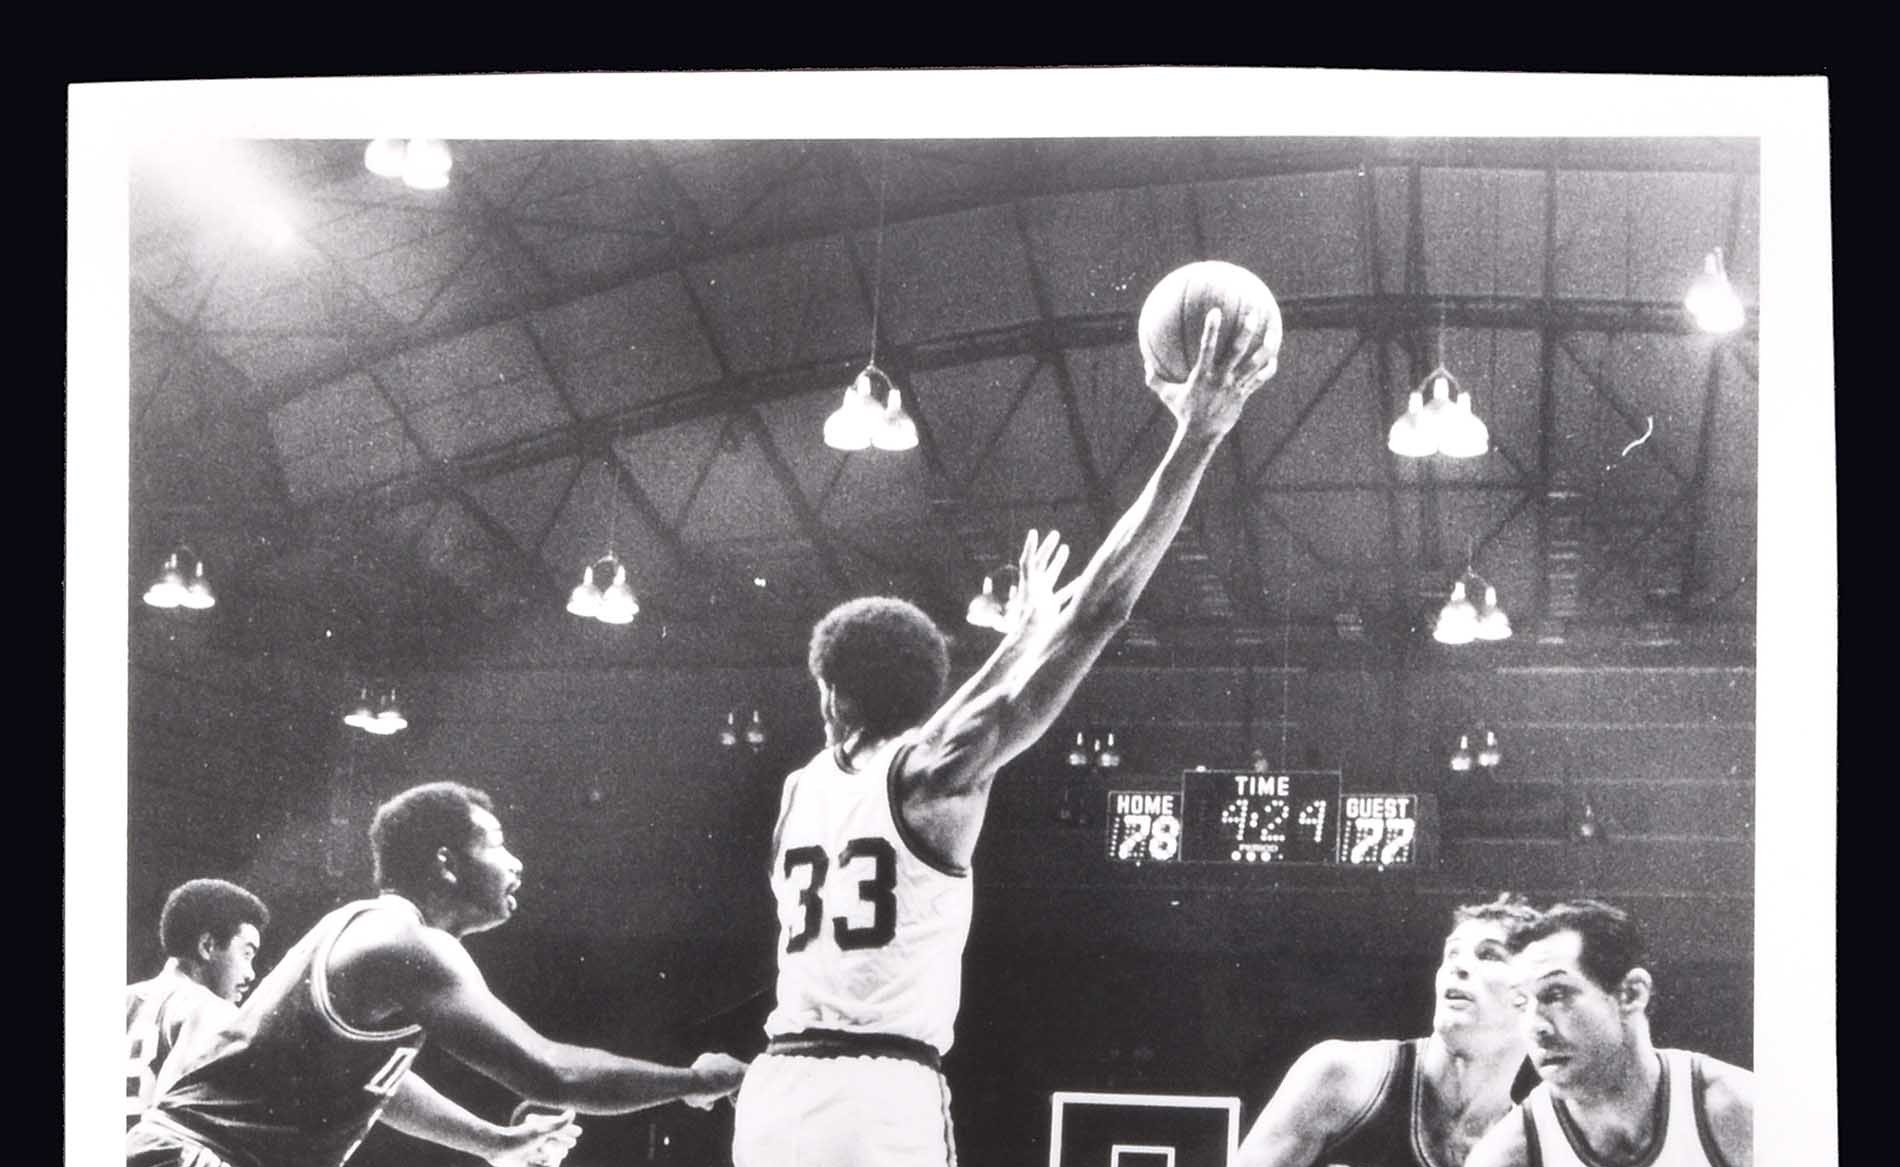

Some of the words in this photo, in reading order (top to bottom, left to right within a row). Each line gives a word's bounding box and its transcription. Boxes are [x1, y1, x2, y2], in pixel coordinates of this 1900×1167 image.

[1234, 776, 1290, 796] TIME
[1117, 794, 1174, 815] HOME
[1346, 798, 1410, 818] GUEST
[1118, 815, 1180, 860] 78
[1350, 818, 1416, 865] 77
[784, 837, 897, 954] 33
